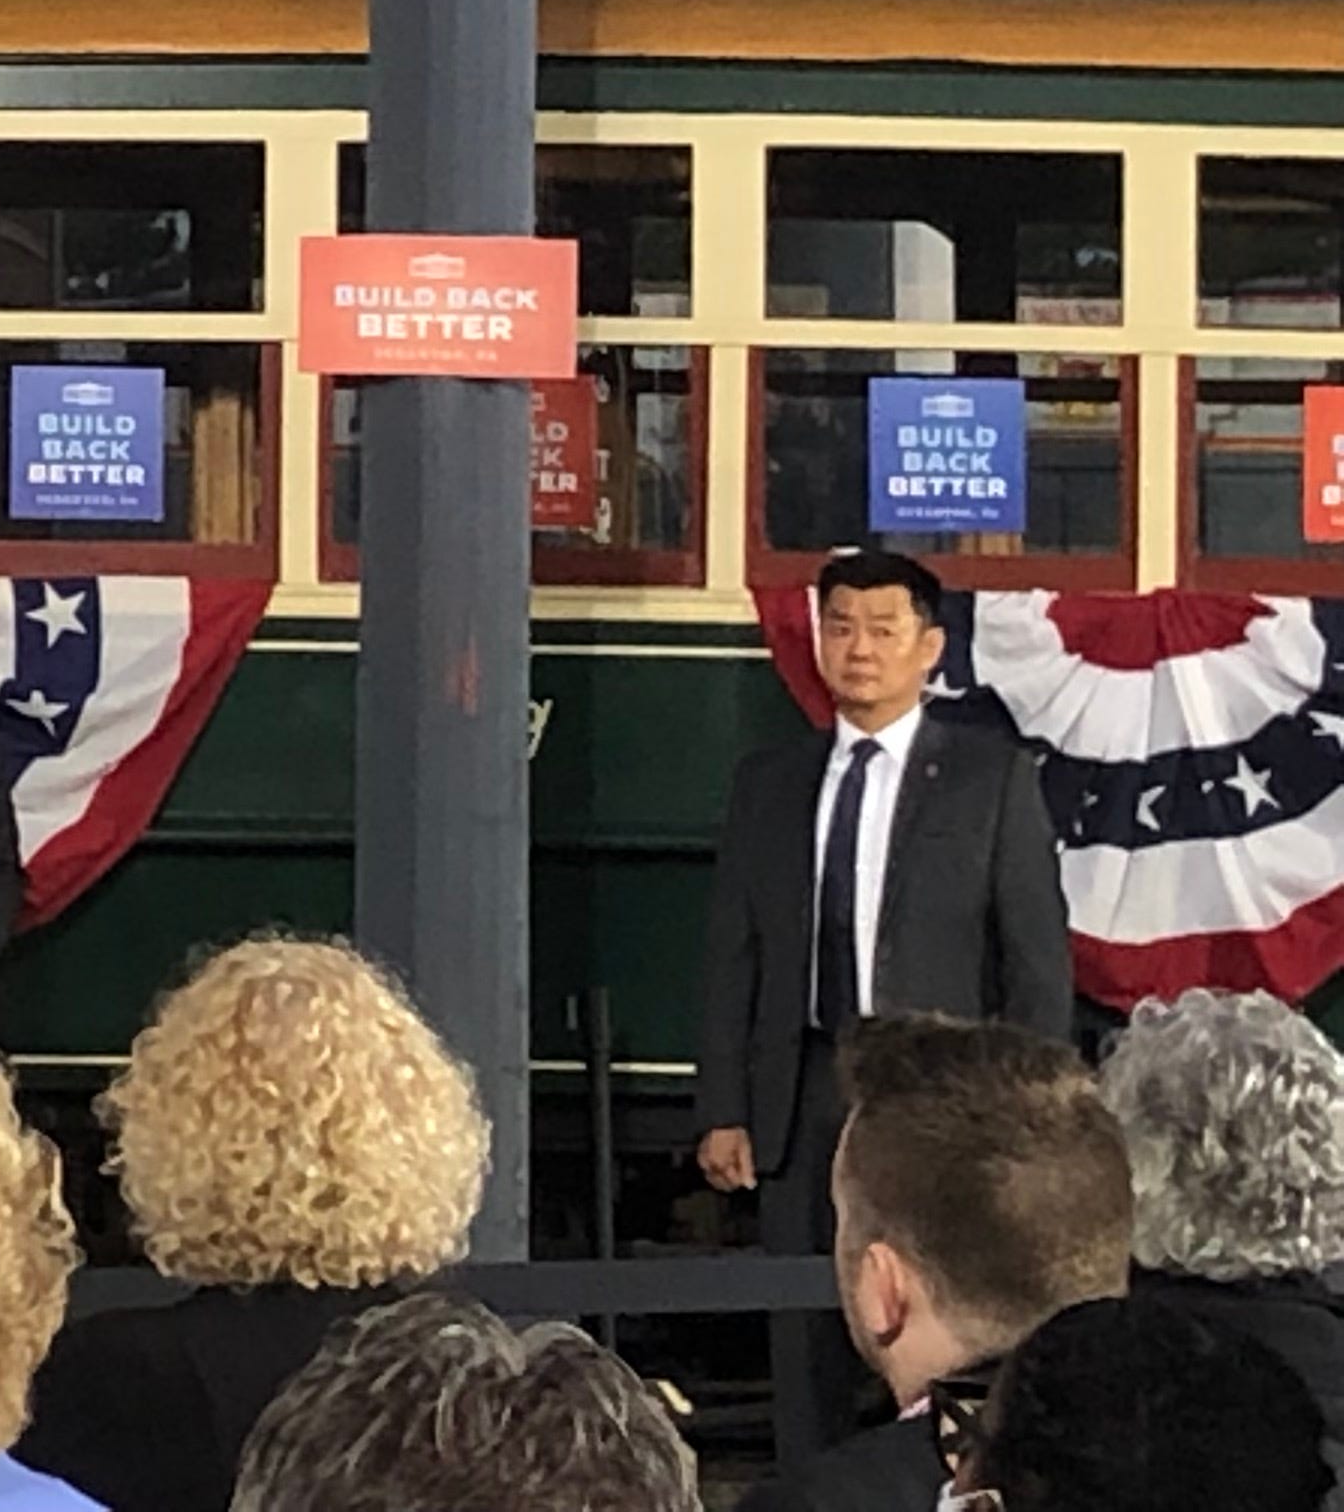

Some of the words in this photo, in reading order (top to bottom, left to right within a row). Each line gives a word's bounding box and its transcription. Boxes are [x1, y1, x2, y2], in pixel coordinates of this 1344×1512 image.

[334, 284, 436, 308] BUILD
[447, 288, 538, 310] BACK
[357, 313, 513, 341] BETTER
[38, 413, 136, 435] BUILD
[898, 425, 998, 448] BUILD
[42, 439, 130, 461] BACK
[903, 451, 992, 473] BACK
[28, 463, 145, 486] BETTER
[888, 476, 1007, 498] BETTER
